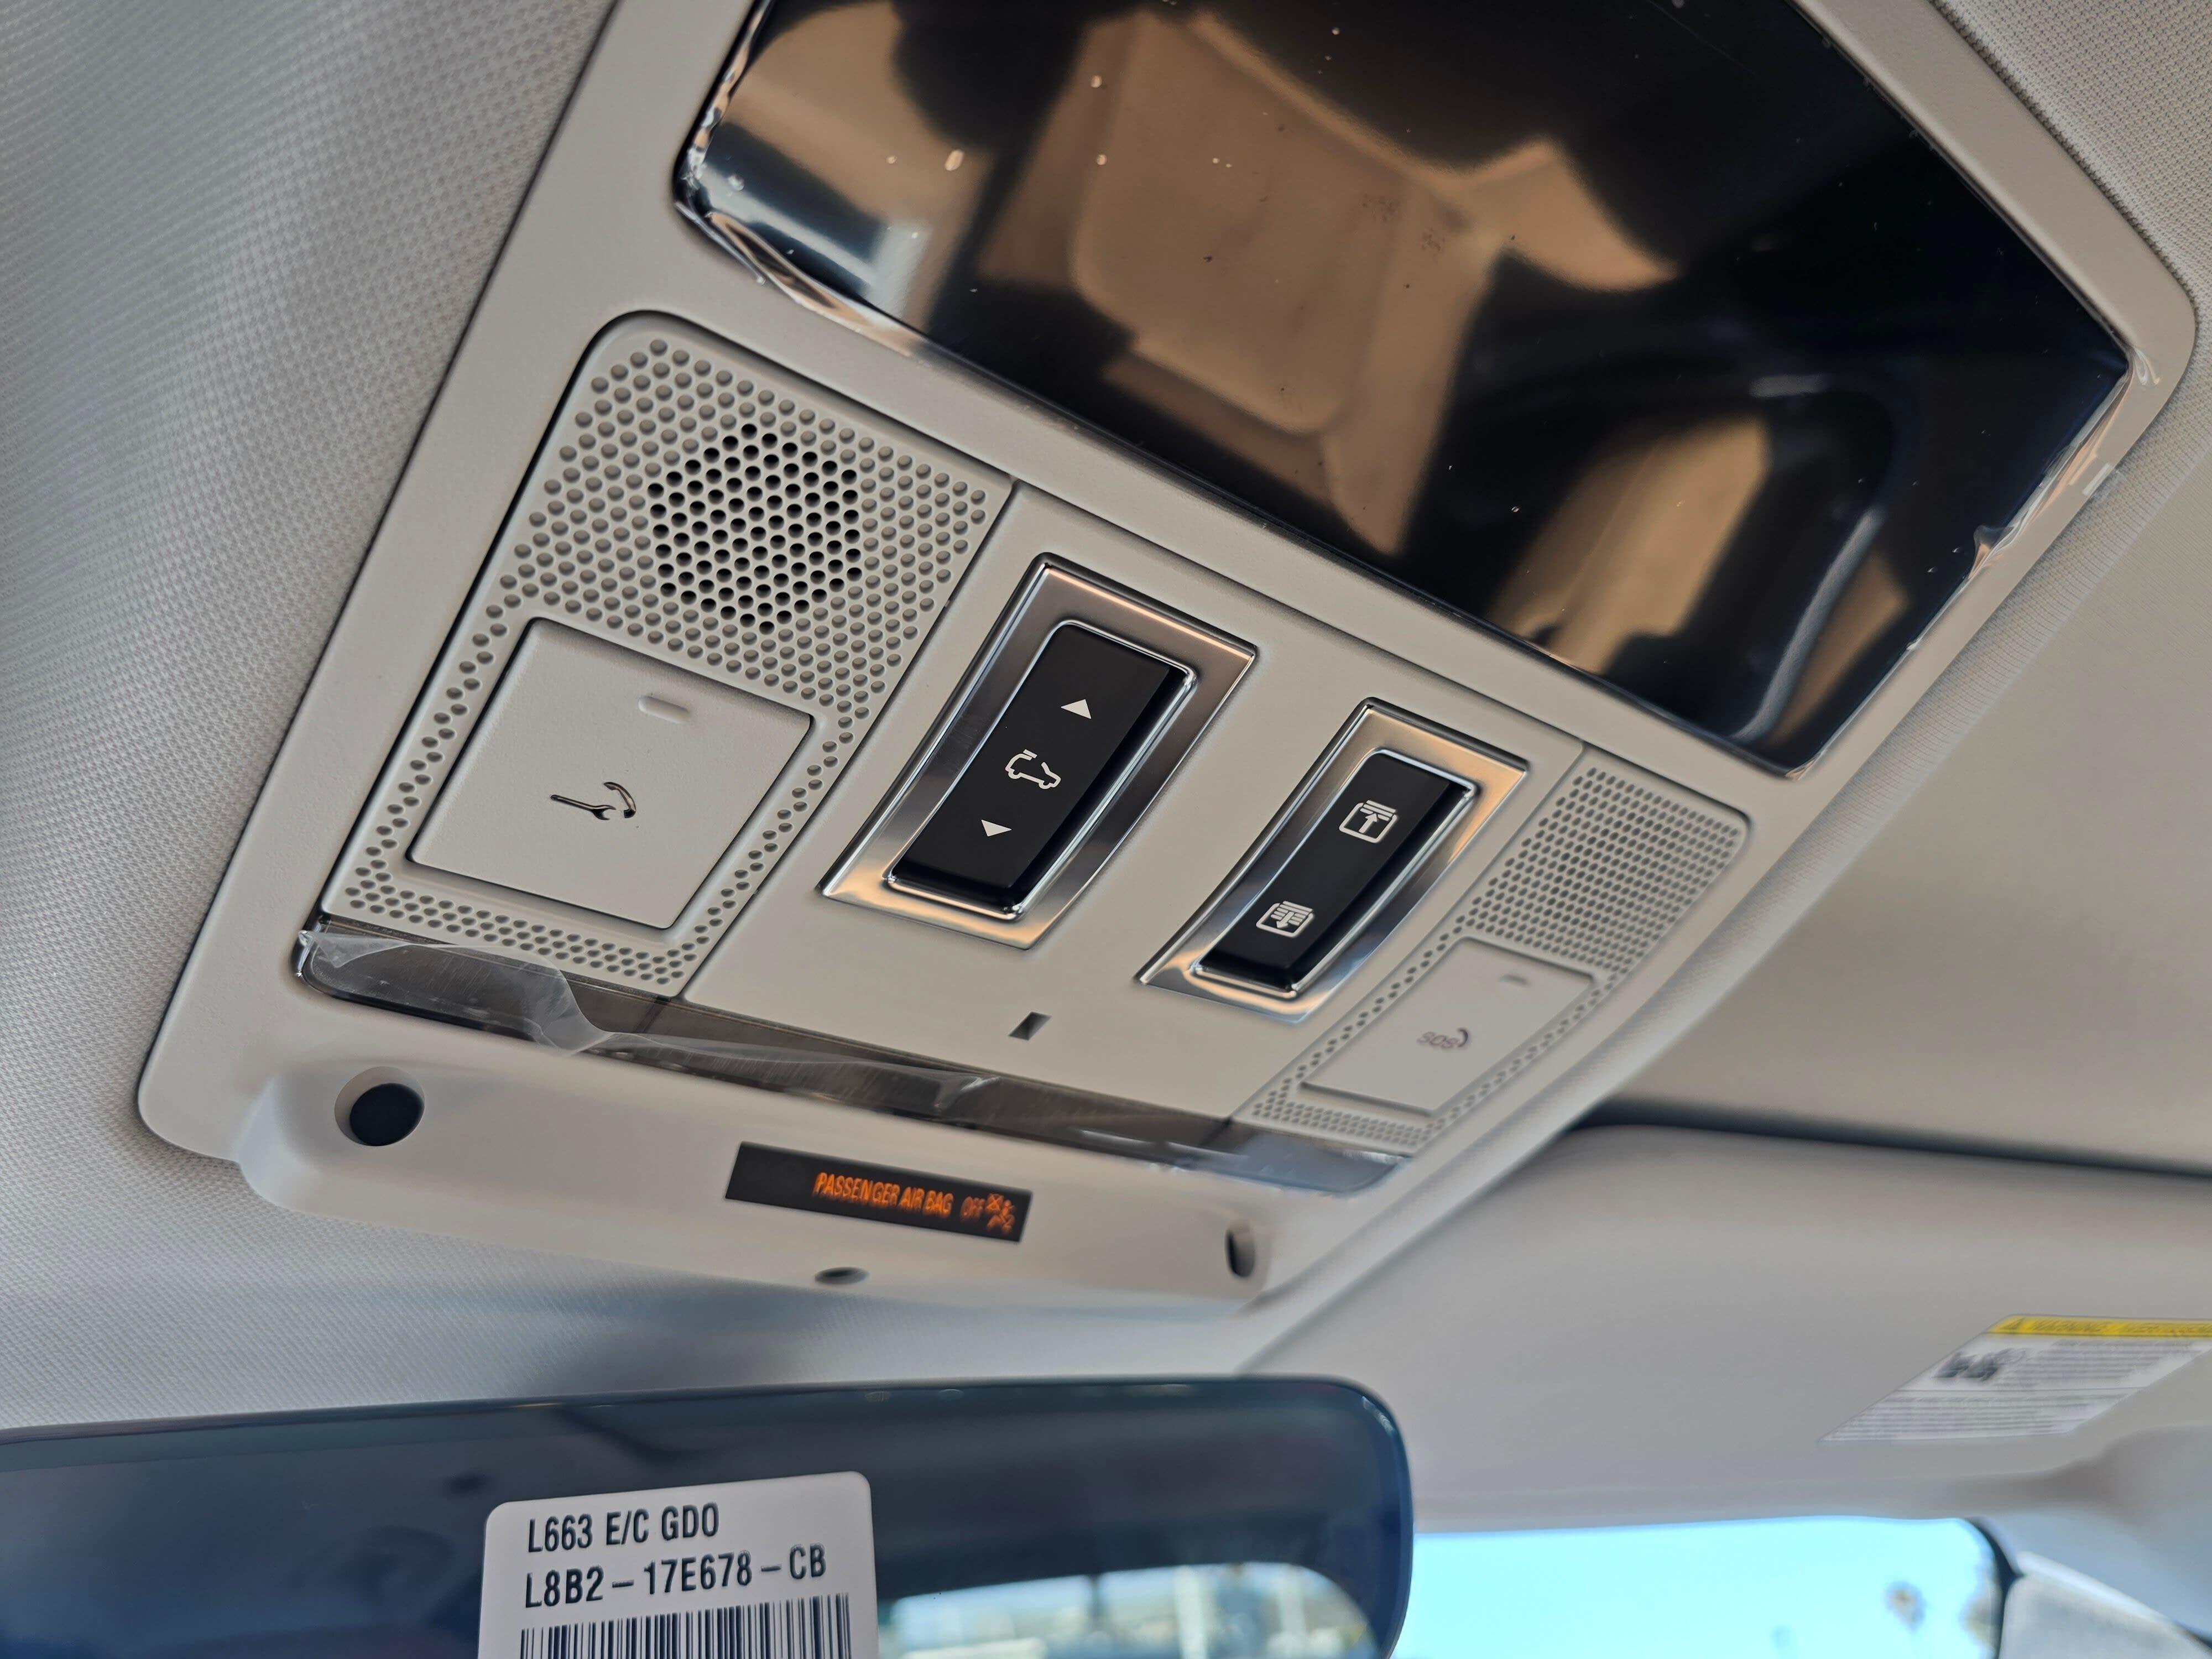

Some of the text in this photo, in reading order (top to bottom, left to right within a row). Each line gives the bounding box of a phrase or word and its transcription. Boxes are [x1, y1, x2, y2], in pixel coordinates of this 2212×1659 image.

[1417, 1031, 1460, 1050] SOS
[813, 1172, 985, 1219] PASSENGER AIR BAG OFF
[528, 1501, 719, 1553] L663 E/C GDO
